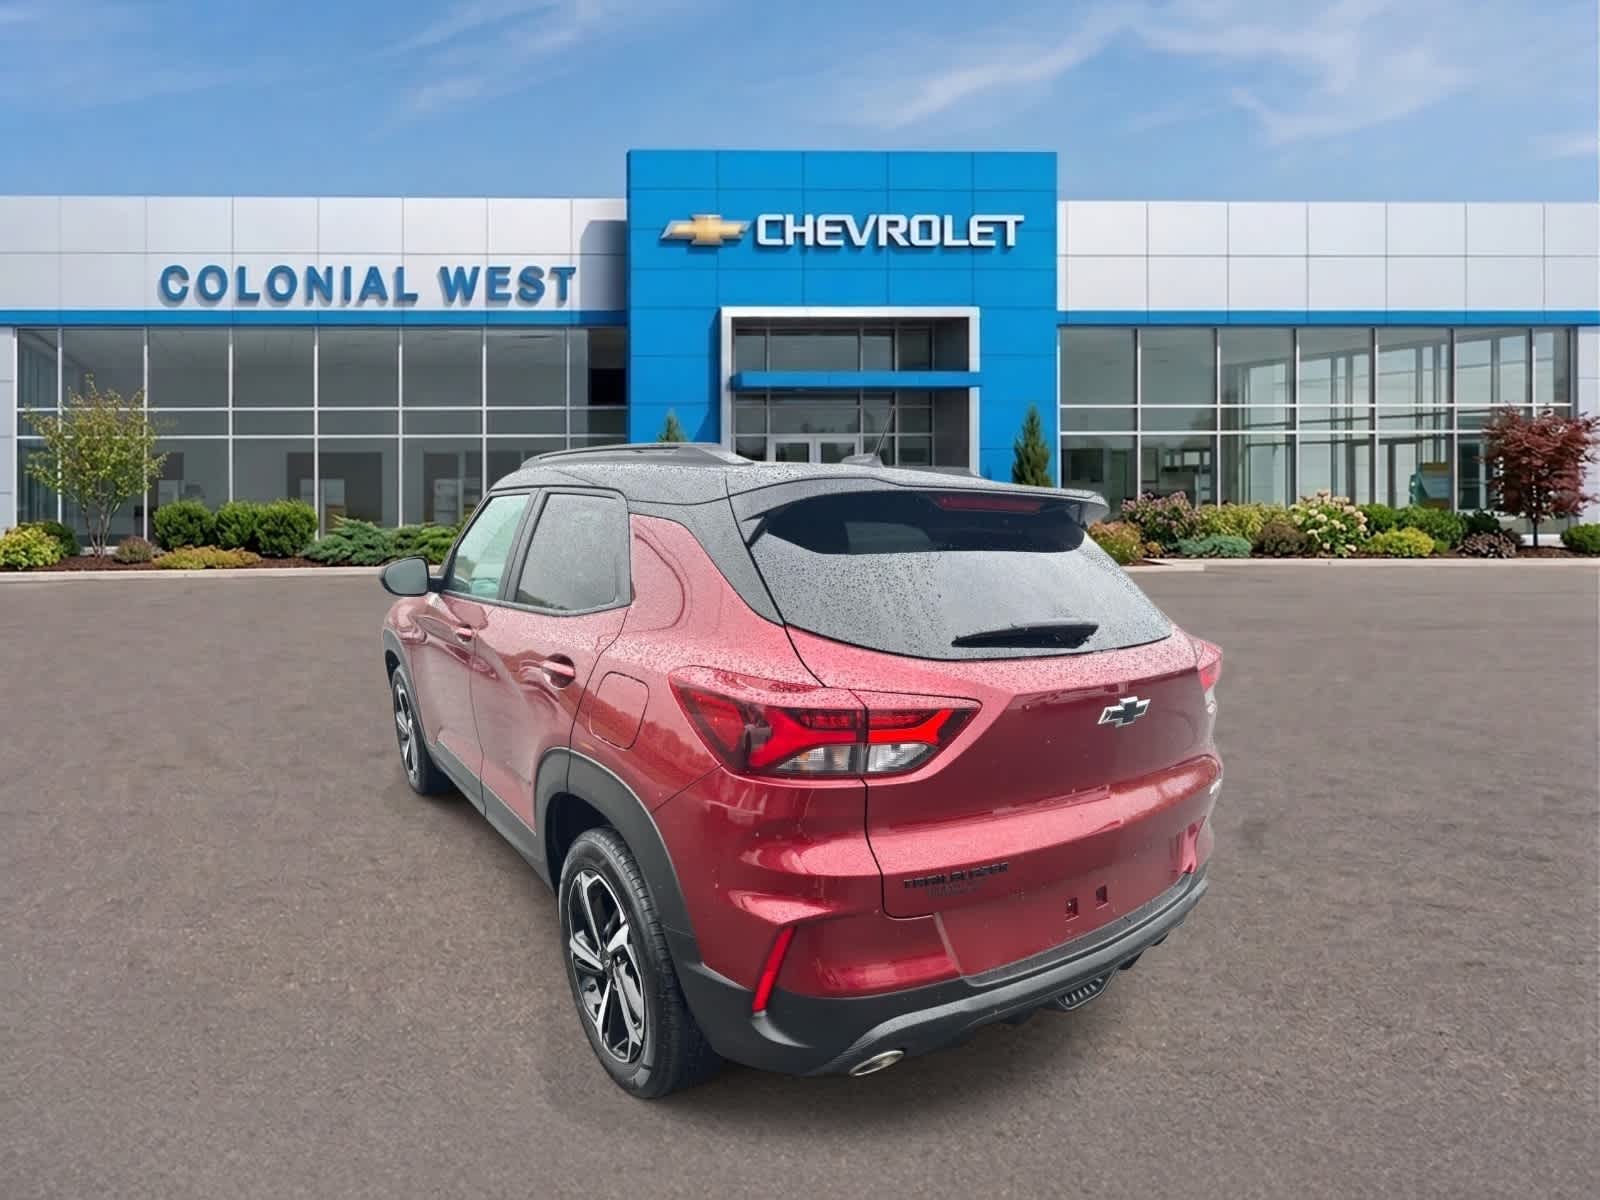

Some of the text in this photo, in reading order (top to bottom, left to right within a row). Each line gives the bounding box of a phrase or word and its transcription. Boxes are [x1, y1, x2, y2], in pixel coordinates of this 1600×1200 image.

[756, 213, 1025, 248] CHEVROLET
[159, 264, 577, 305] COLONIAL WEST
